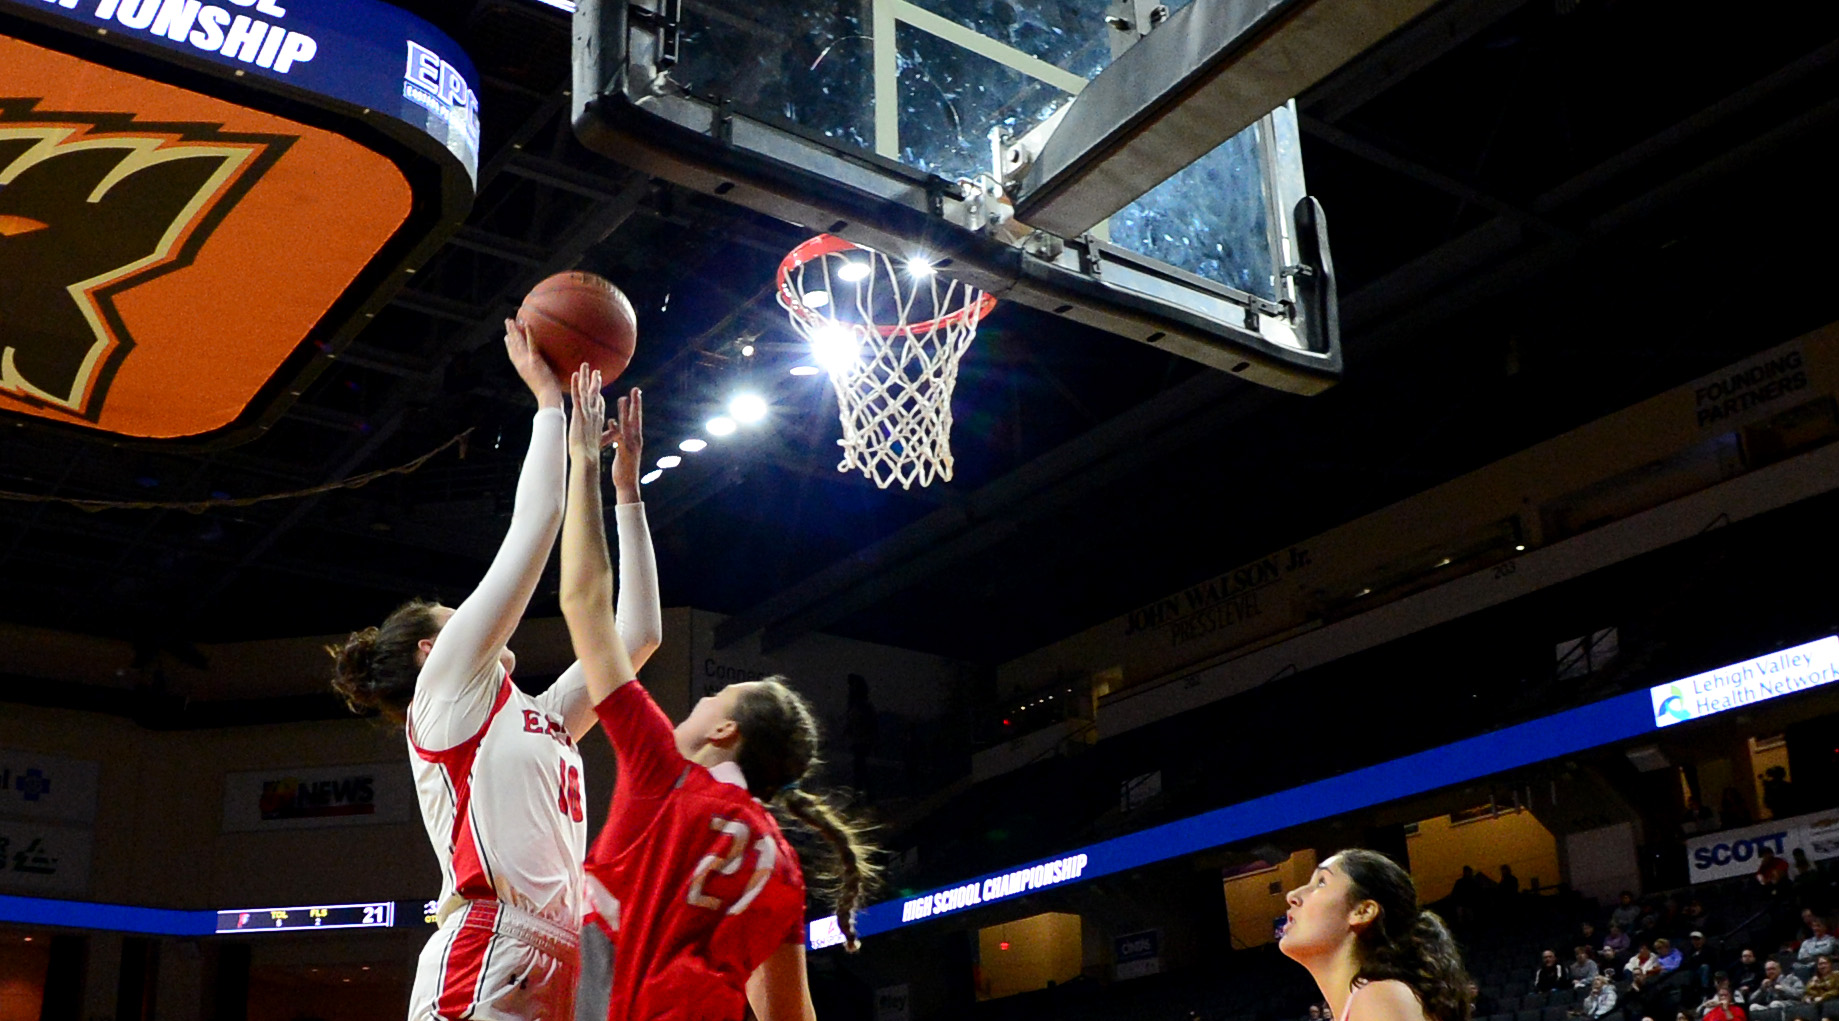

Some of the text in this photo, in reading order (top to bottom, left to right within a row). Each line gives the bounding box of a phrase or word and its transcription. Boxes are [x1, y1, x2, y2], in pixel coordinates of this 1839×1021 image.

[1695, 350, 1802, 406] FOUNDING
[1696, 371, 1808, 428] PARTNERS
[1124, 546, 1312, 636] JOHN WALSON Jr.
[1692, 651, 1813, 695] Lehigh Valley
[1695, 661, 1839, 714] Health Network
[297, 777, 374, 805] NEWS
[686, 814, 777, 915] 21
[1694, 830, 1789, 871] SCOTT
[362, 906, 384, 924] 21
[901, 852, 1089, 924] HIGH SCHOOL CHAMPIONSHIP
